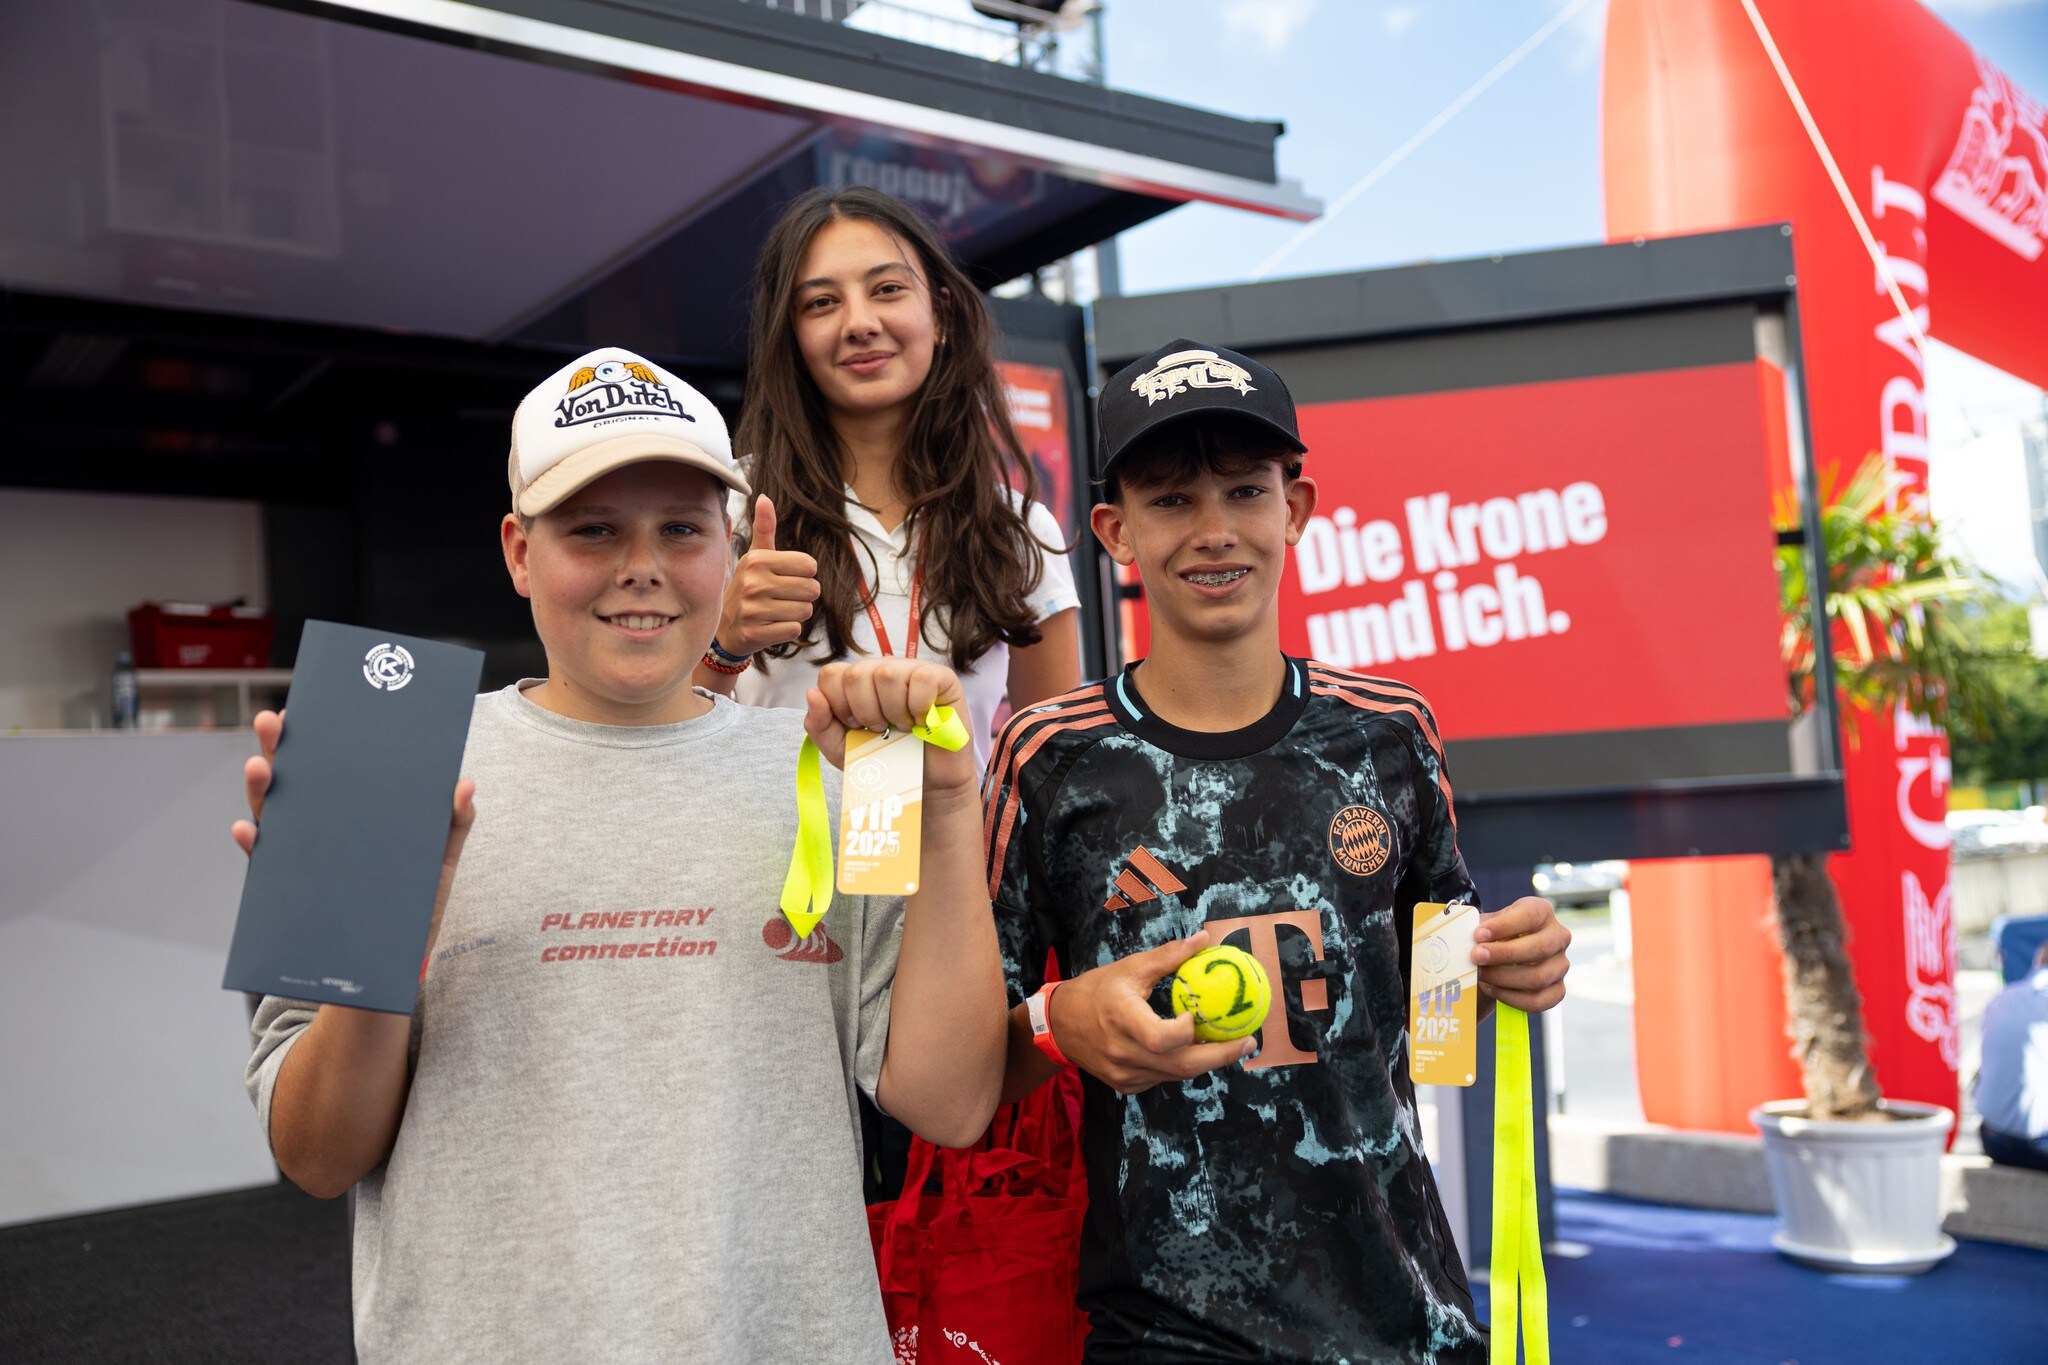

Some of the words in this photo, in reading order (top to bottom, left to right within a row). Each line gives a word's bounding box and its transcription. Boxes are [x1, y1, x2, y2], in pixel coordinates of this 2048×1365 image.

[554, 386, 606, 427] Von
[604, 381, 696, 422] Dutch
[1294, 506, 1404, 595] Die
[1404, 481, 1608, 574] Krone
[1306, 578, 1436, 671] und
[1433, 562, 1571, 652] ich.
[848, 794, 903, 831] VIP
[1333, 818, 1345, 836] FC
[1343, 808, 1387, 835] BAYERN
[845, 830, 900, 858] 2025
[541, 907, 716, 932] PLANETARY
[541, 936, 718, 963] connection
[1416, 977, 1462, 1016] VIP
[1415, 1016, 1461, 1045] 2025
